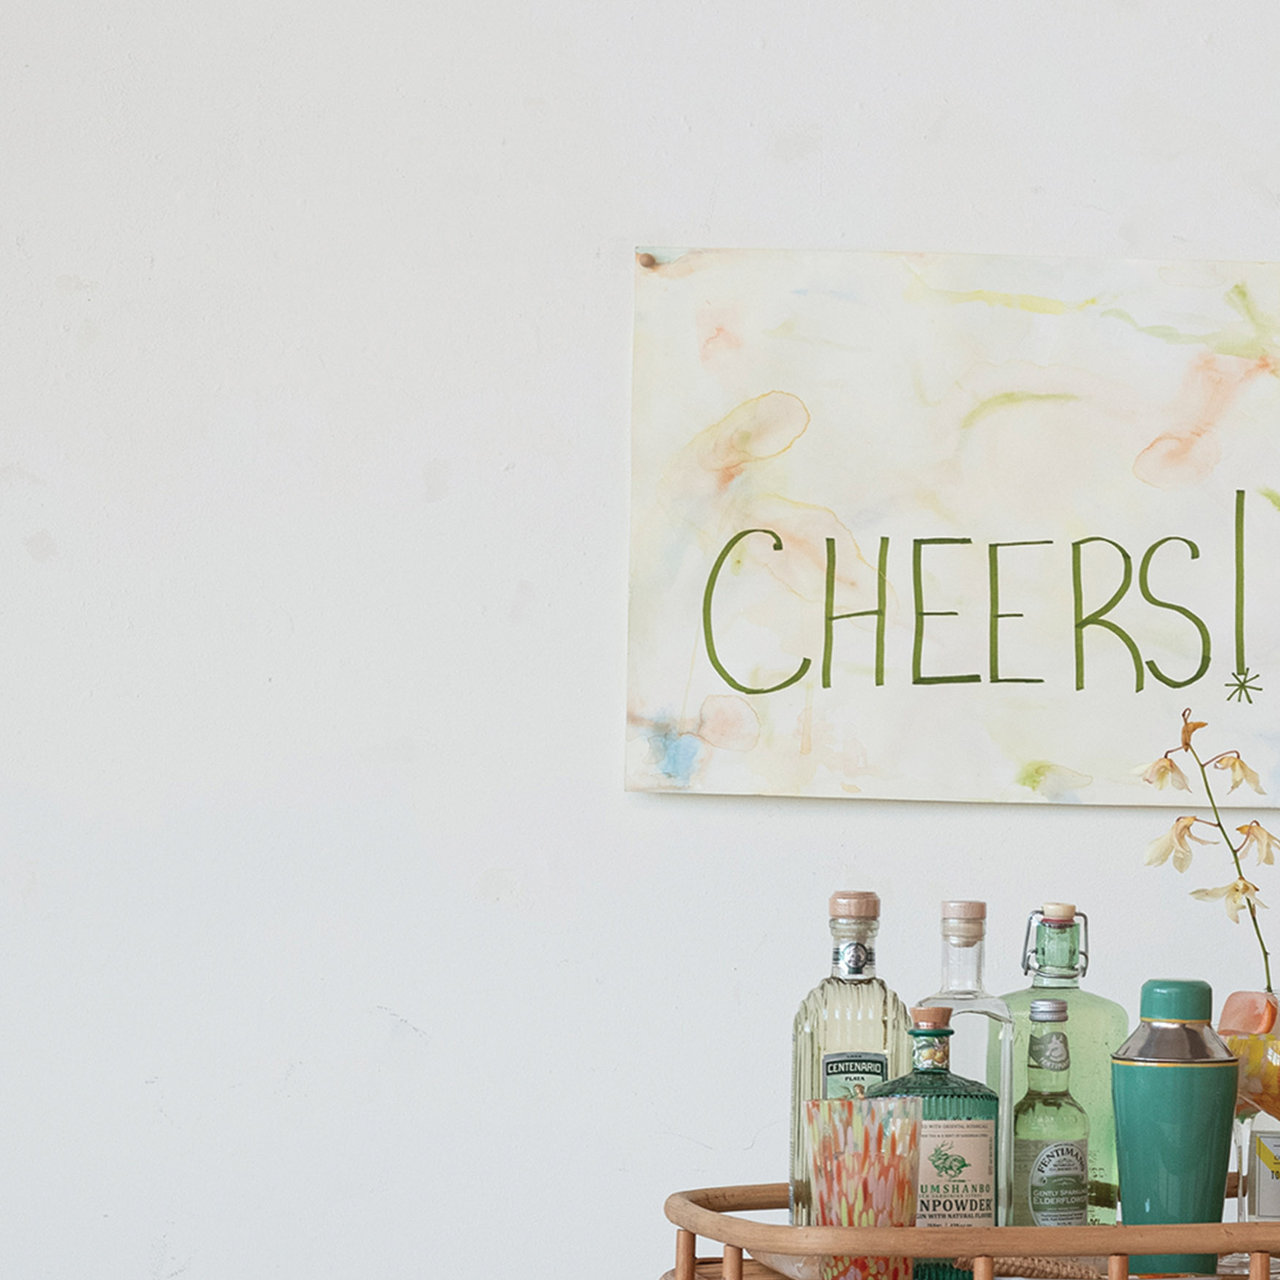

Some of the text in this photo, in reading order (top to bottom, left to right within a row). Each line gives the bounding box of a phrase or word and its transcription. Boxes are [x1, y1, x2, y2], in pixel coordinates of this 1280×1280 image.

[703, 490, 1262, 703] CHEERS!
[827, 1062, 882, 1073] CENTENARIO
[920, 1183, 991, 1194] UMSHANBO
[919, 1199, 993, 1212] NPOWDER
